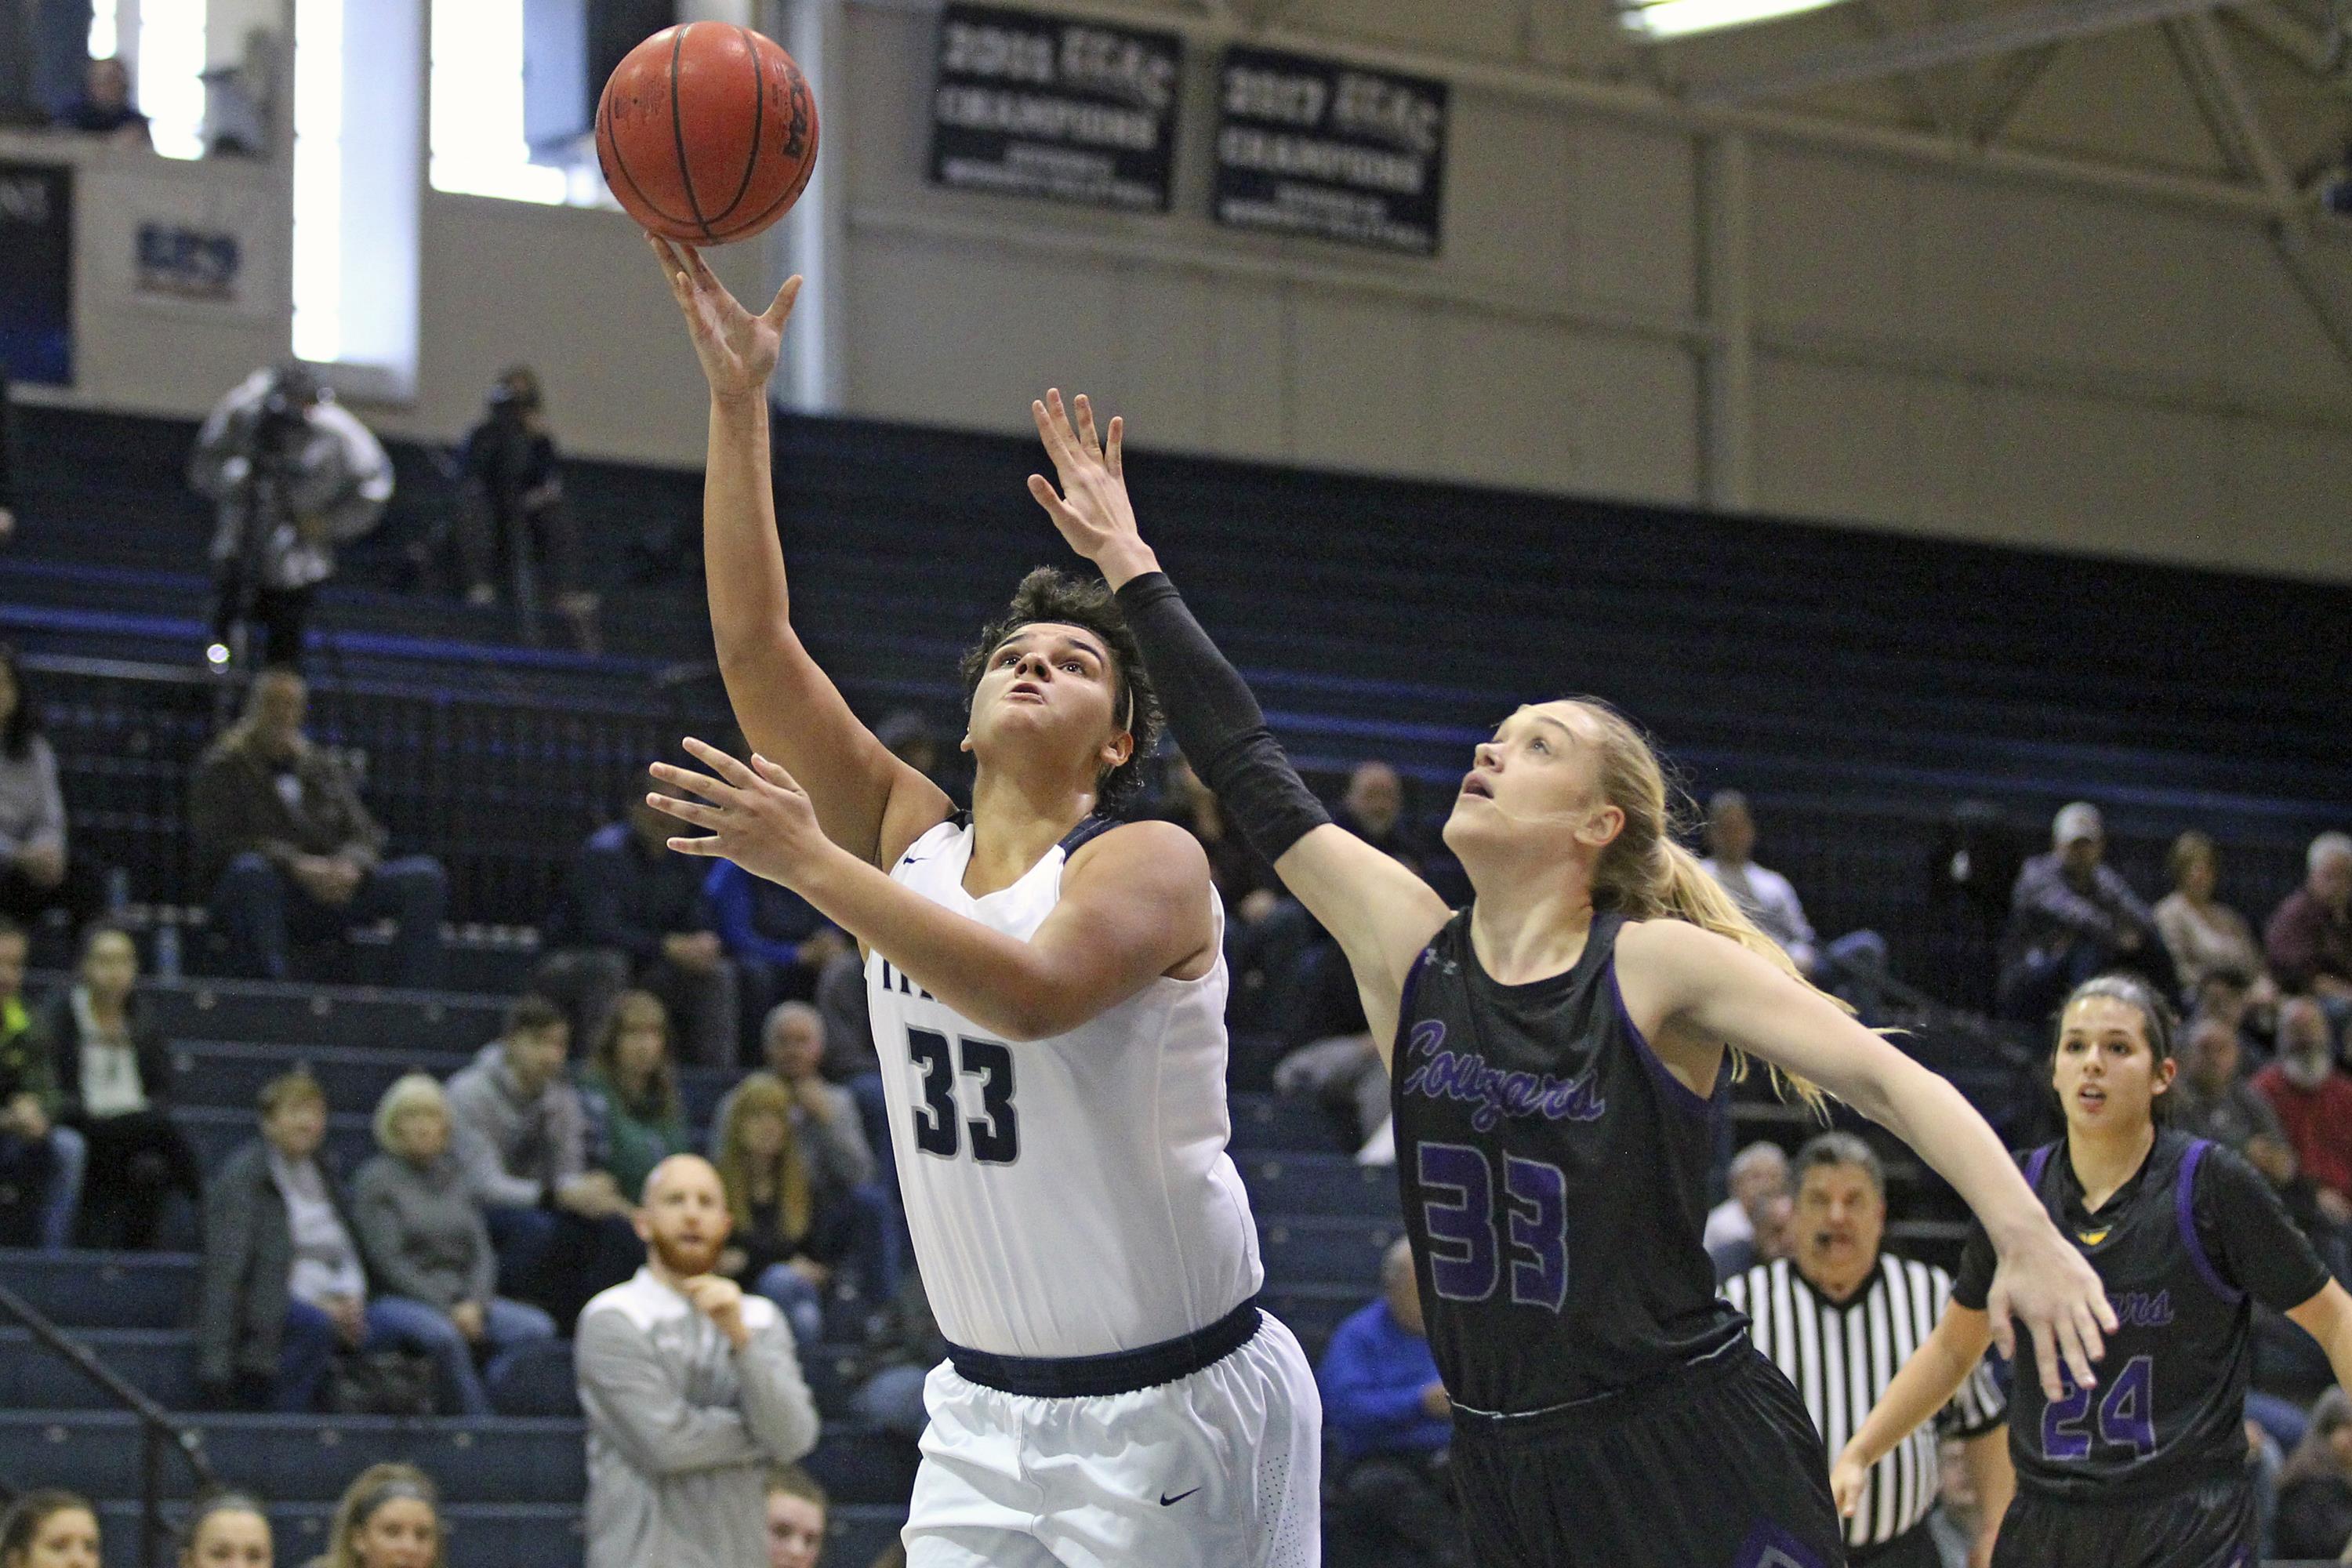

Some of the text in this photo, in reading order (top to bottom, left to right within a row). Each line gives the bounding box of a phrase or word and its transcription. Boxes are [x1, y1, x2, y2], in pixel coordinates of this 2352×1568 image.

[904, 1022, 1022, 1168] 33
[1403, 1019, 1606, 1133] Cougars
[1417, 1141, 1568, 1315] 33
[2042, 1354, 2157, 1461] 24
